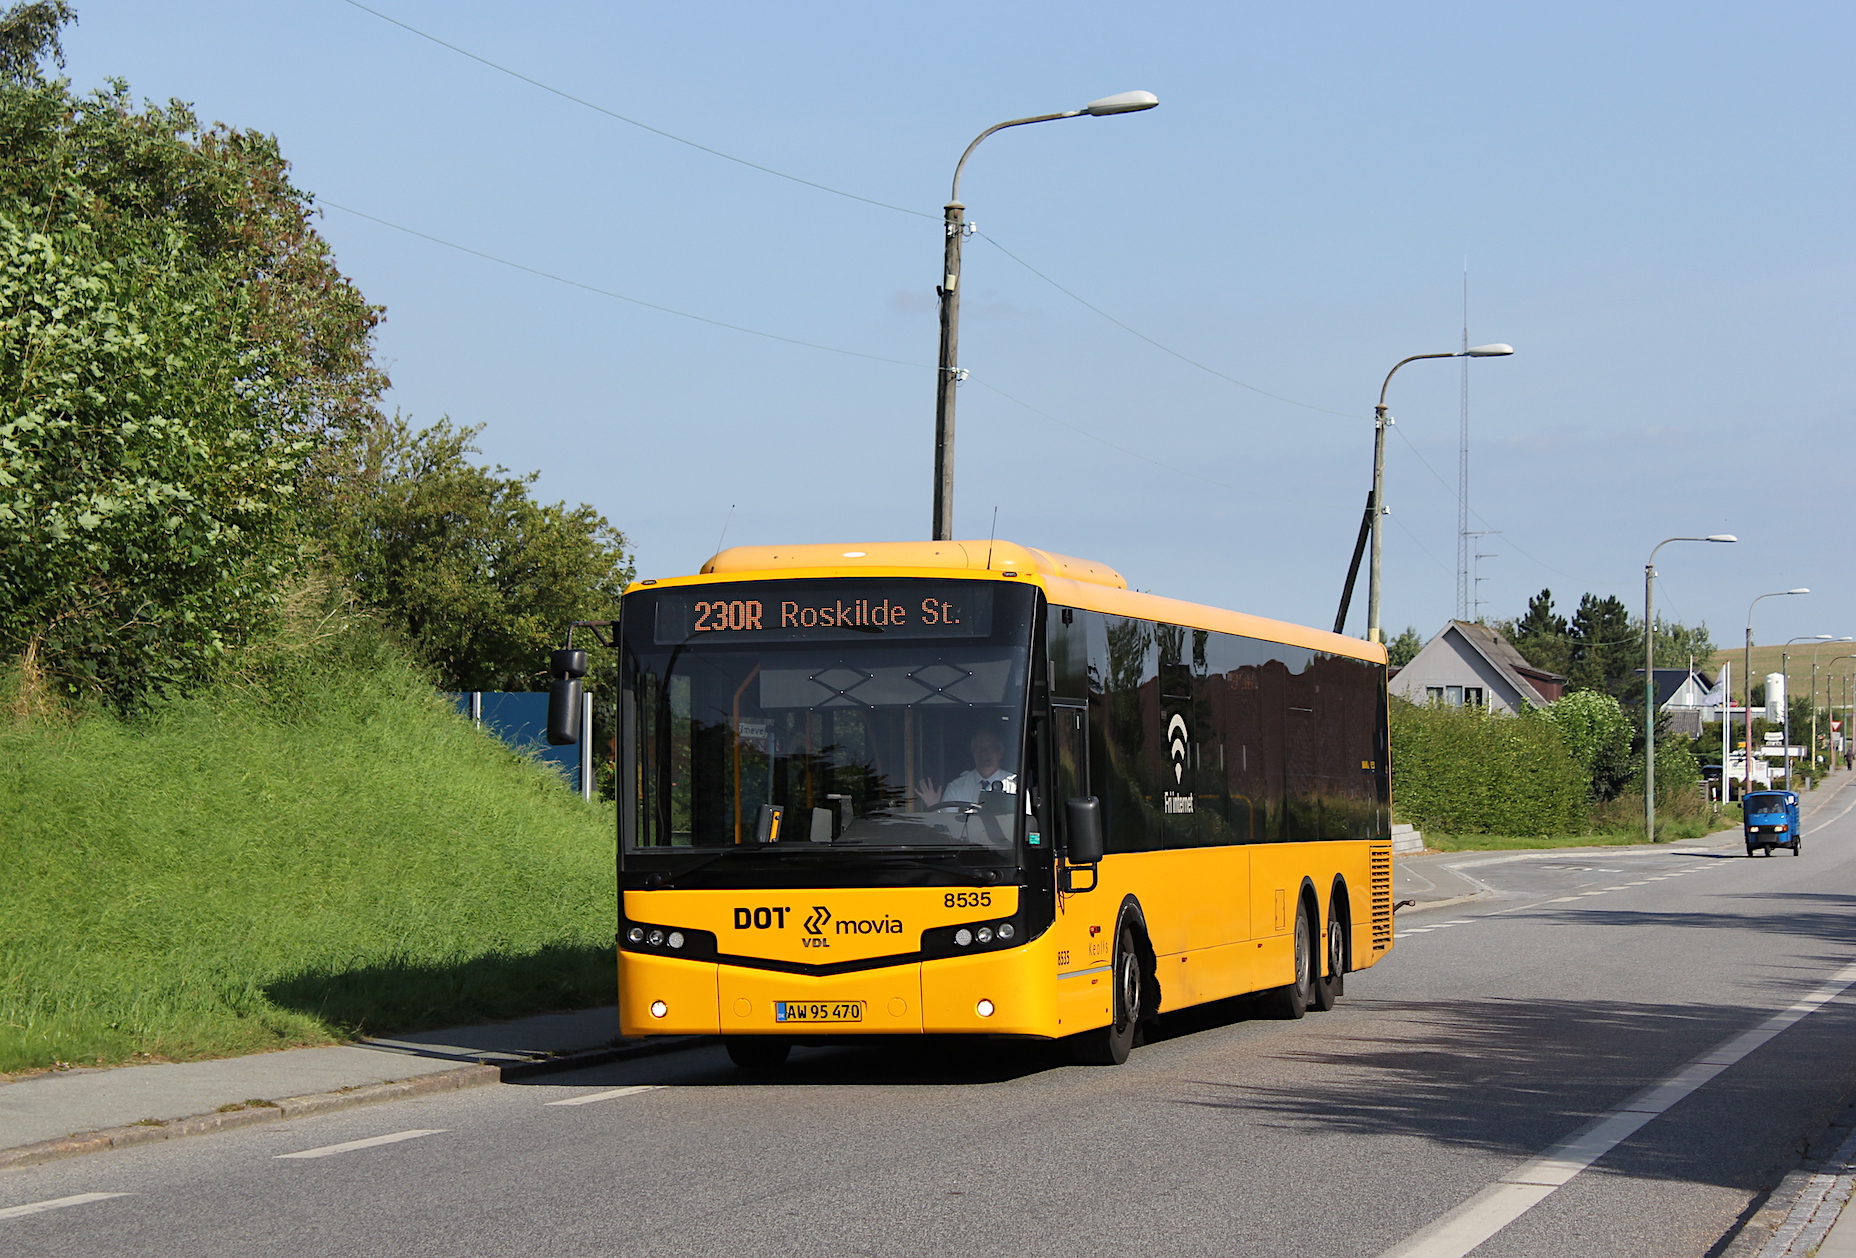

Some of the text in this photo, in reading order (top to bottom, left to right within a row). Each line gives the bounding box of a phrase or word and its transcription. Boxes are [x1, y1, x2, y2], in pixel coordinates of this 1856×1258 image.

[694, 597, 961, 631] 230R Roskilde St.
[944, 892, 992, 908] 8535
[734, 906, 791, 930] DOT
[836, 914, 903, 934] movia
[802, 938, 830, 948] VDL
[1088, 940, 1109, 957] Keolis
[1057, 950, 1070, 966] 8535
[787, 1004, 860, 1019] AW 95 470
